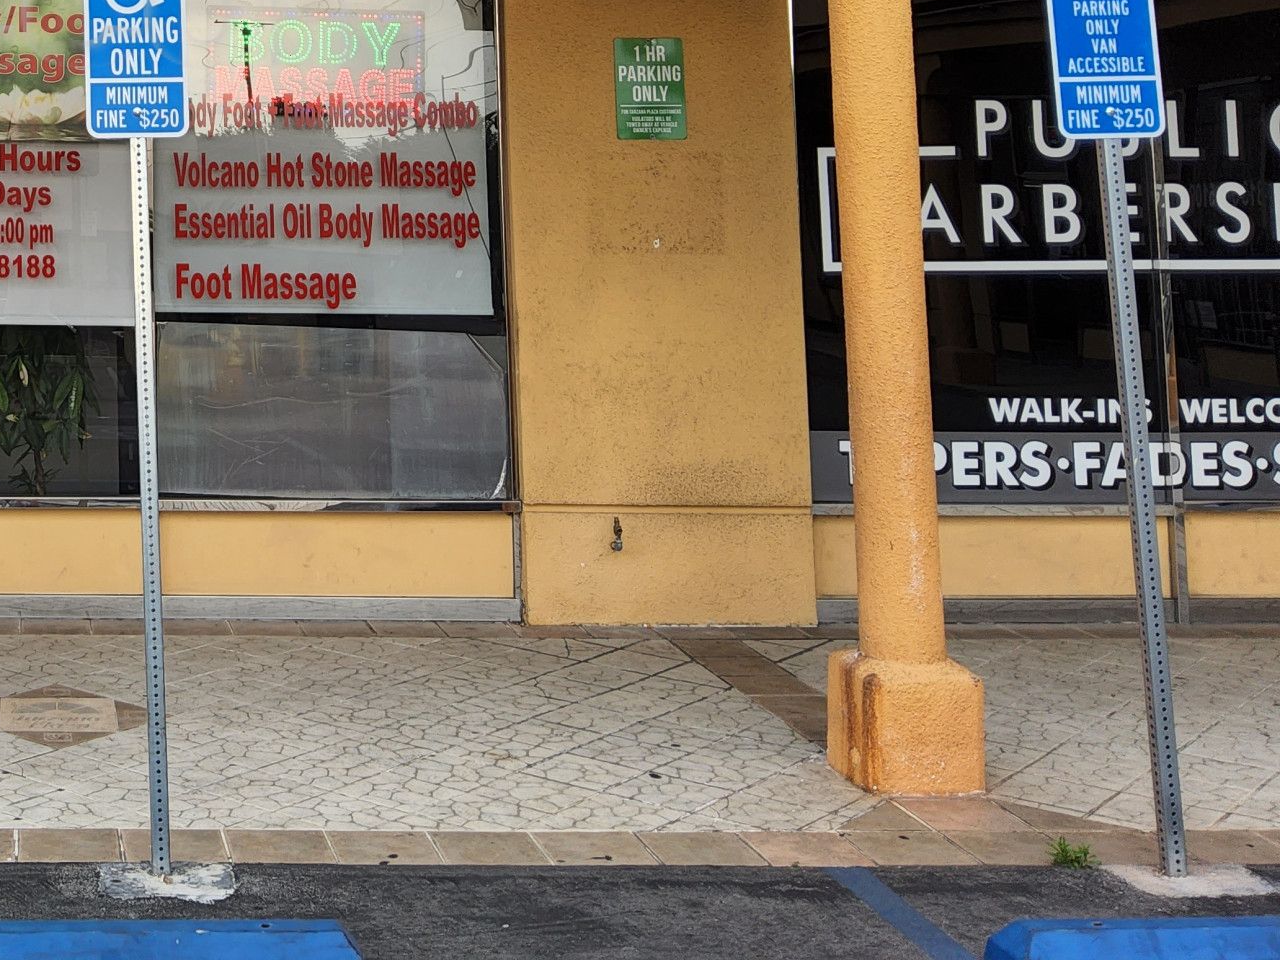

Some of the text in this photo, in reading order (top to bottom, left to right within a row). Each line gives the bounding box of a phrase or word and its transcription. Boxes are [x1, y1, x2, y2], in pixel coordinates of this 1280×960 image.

[1072, 0, 1130, 16] PARKING
[93, 15, 179, 44] PARKING
[1085, 19, 1119, 35] ONLY
[228, 19, 401, 67] BODY
[633, 46, 666, 61] 1 HR
[1091, 38, 1117, 54] VAN
[110, 48, 163, 76] ONLY
[618, 65, 681, 82] PARKING
[1068, 56, 1146, 74] ACCESSIBLE
[106, 86, 168, 105] MINIMUM
[209, 65, 419, 108] MASSAGE
[632, 85, 668, 102] ONLY
[1076, 84, 1142, 105] MINIMUM
[96, 108, 180, 130] FINE $250
[188, 93, 217, 139] ody
[223, 93, 263, 128] Foot
[329, 92, 409, 137] Massage
[415, 91, 478, 129] Combo
[1067, 107, 1155, 130] FINE $250
[975, 99, 1280, 159] PULI
[173, 152, 477, 197] Volcano Hot Stone Massage
[29, 223, 54, 249] pm
[174, 203, 480, 248] Essential Oil Body Massage
[175, 263, 357, 309] Foot Massage
